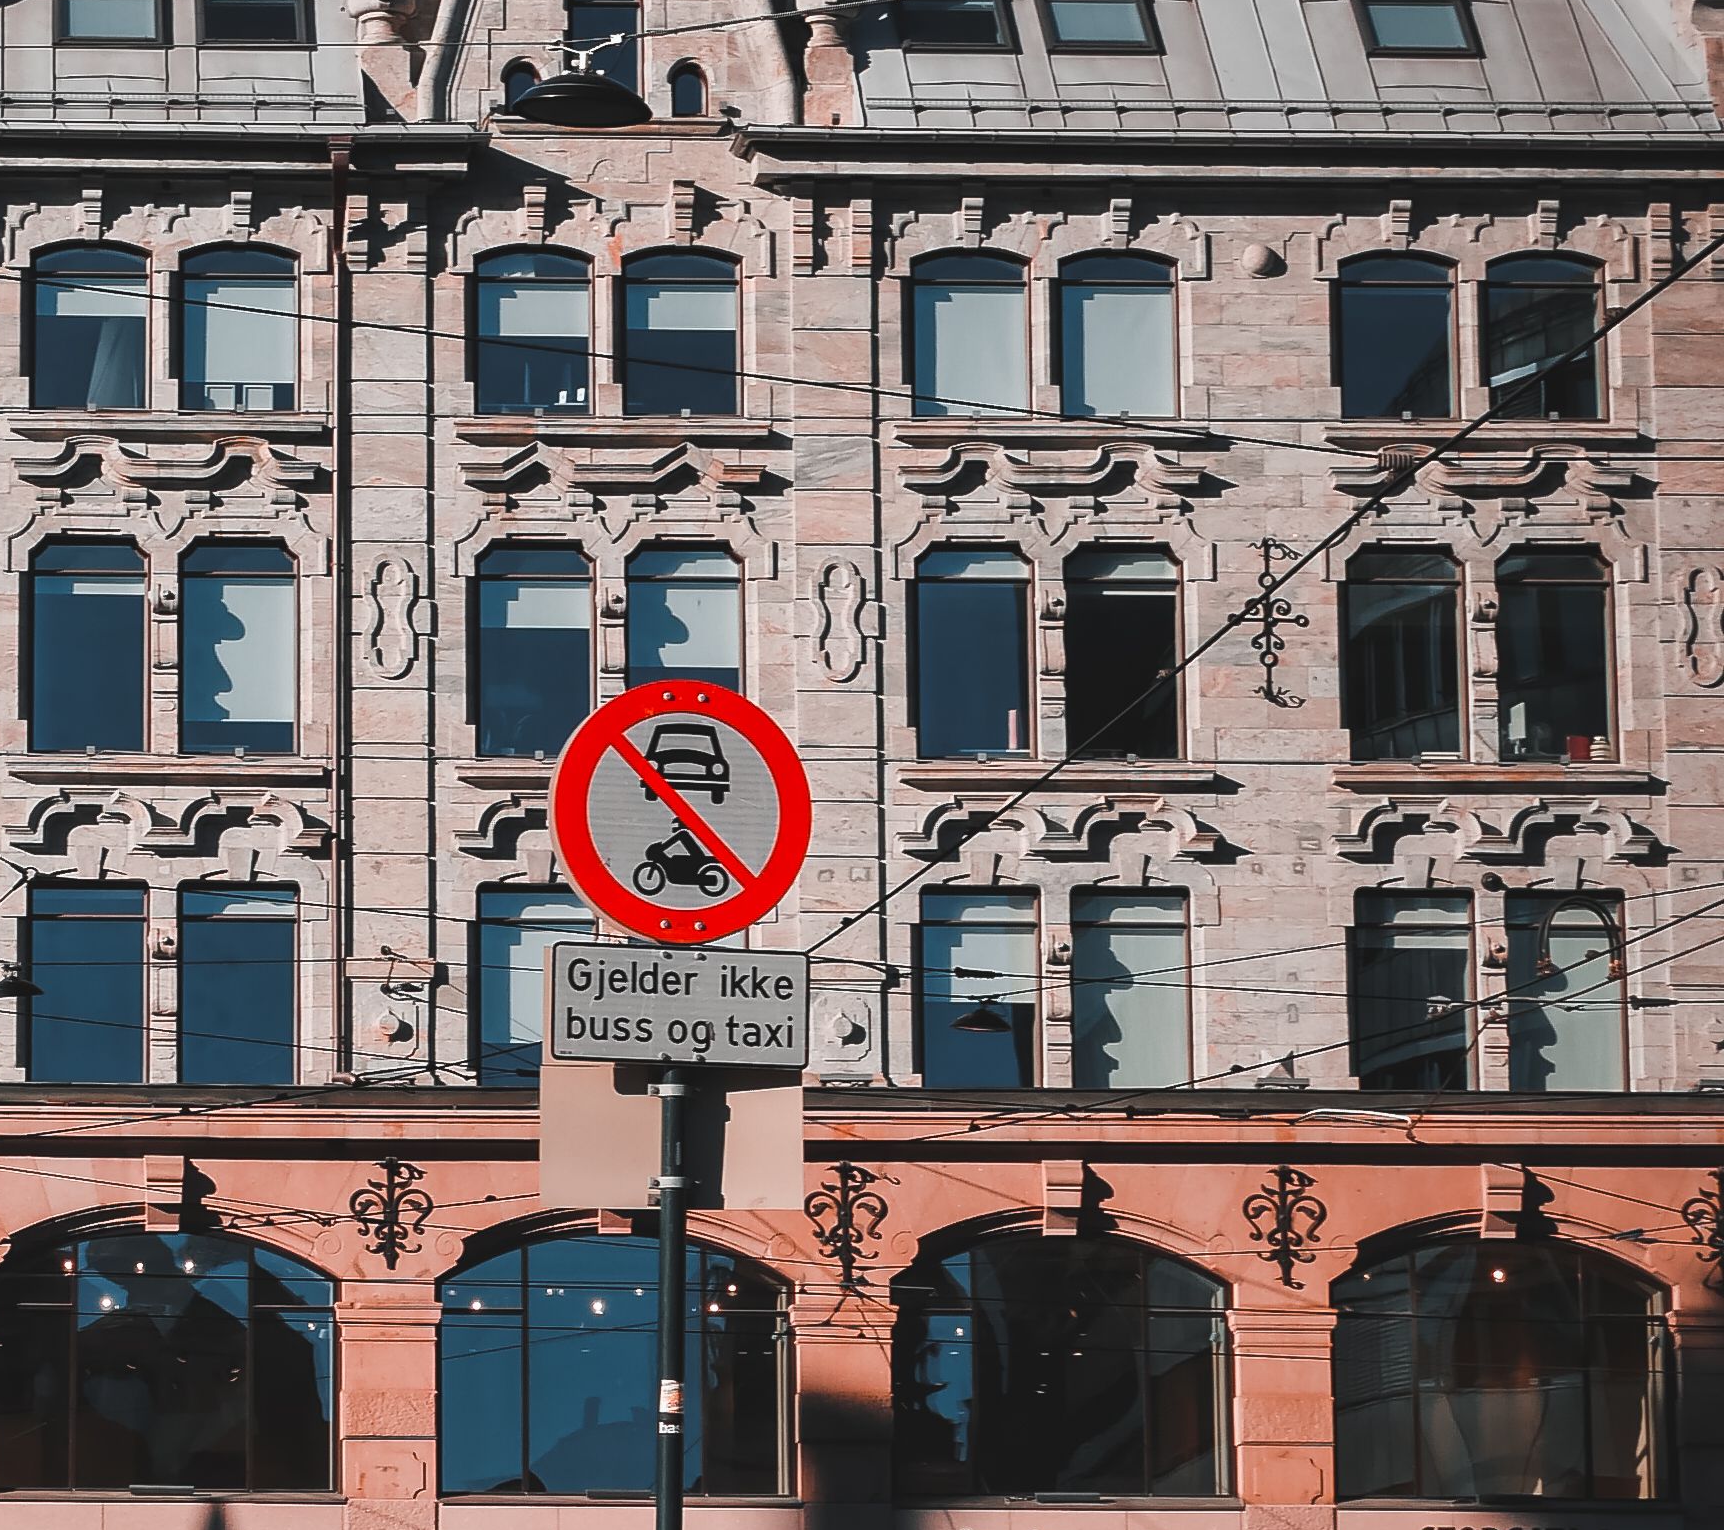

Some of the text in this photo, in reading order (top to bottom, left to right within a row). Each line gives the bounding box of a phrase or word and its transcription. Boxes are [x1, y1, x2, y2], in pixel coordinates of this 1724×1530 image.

[567, 957, 794, 1001] Gjelder ikke
[566, 1006, 794, 1054] buss og taxi
